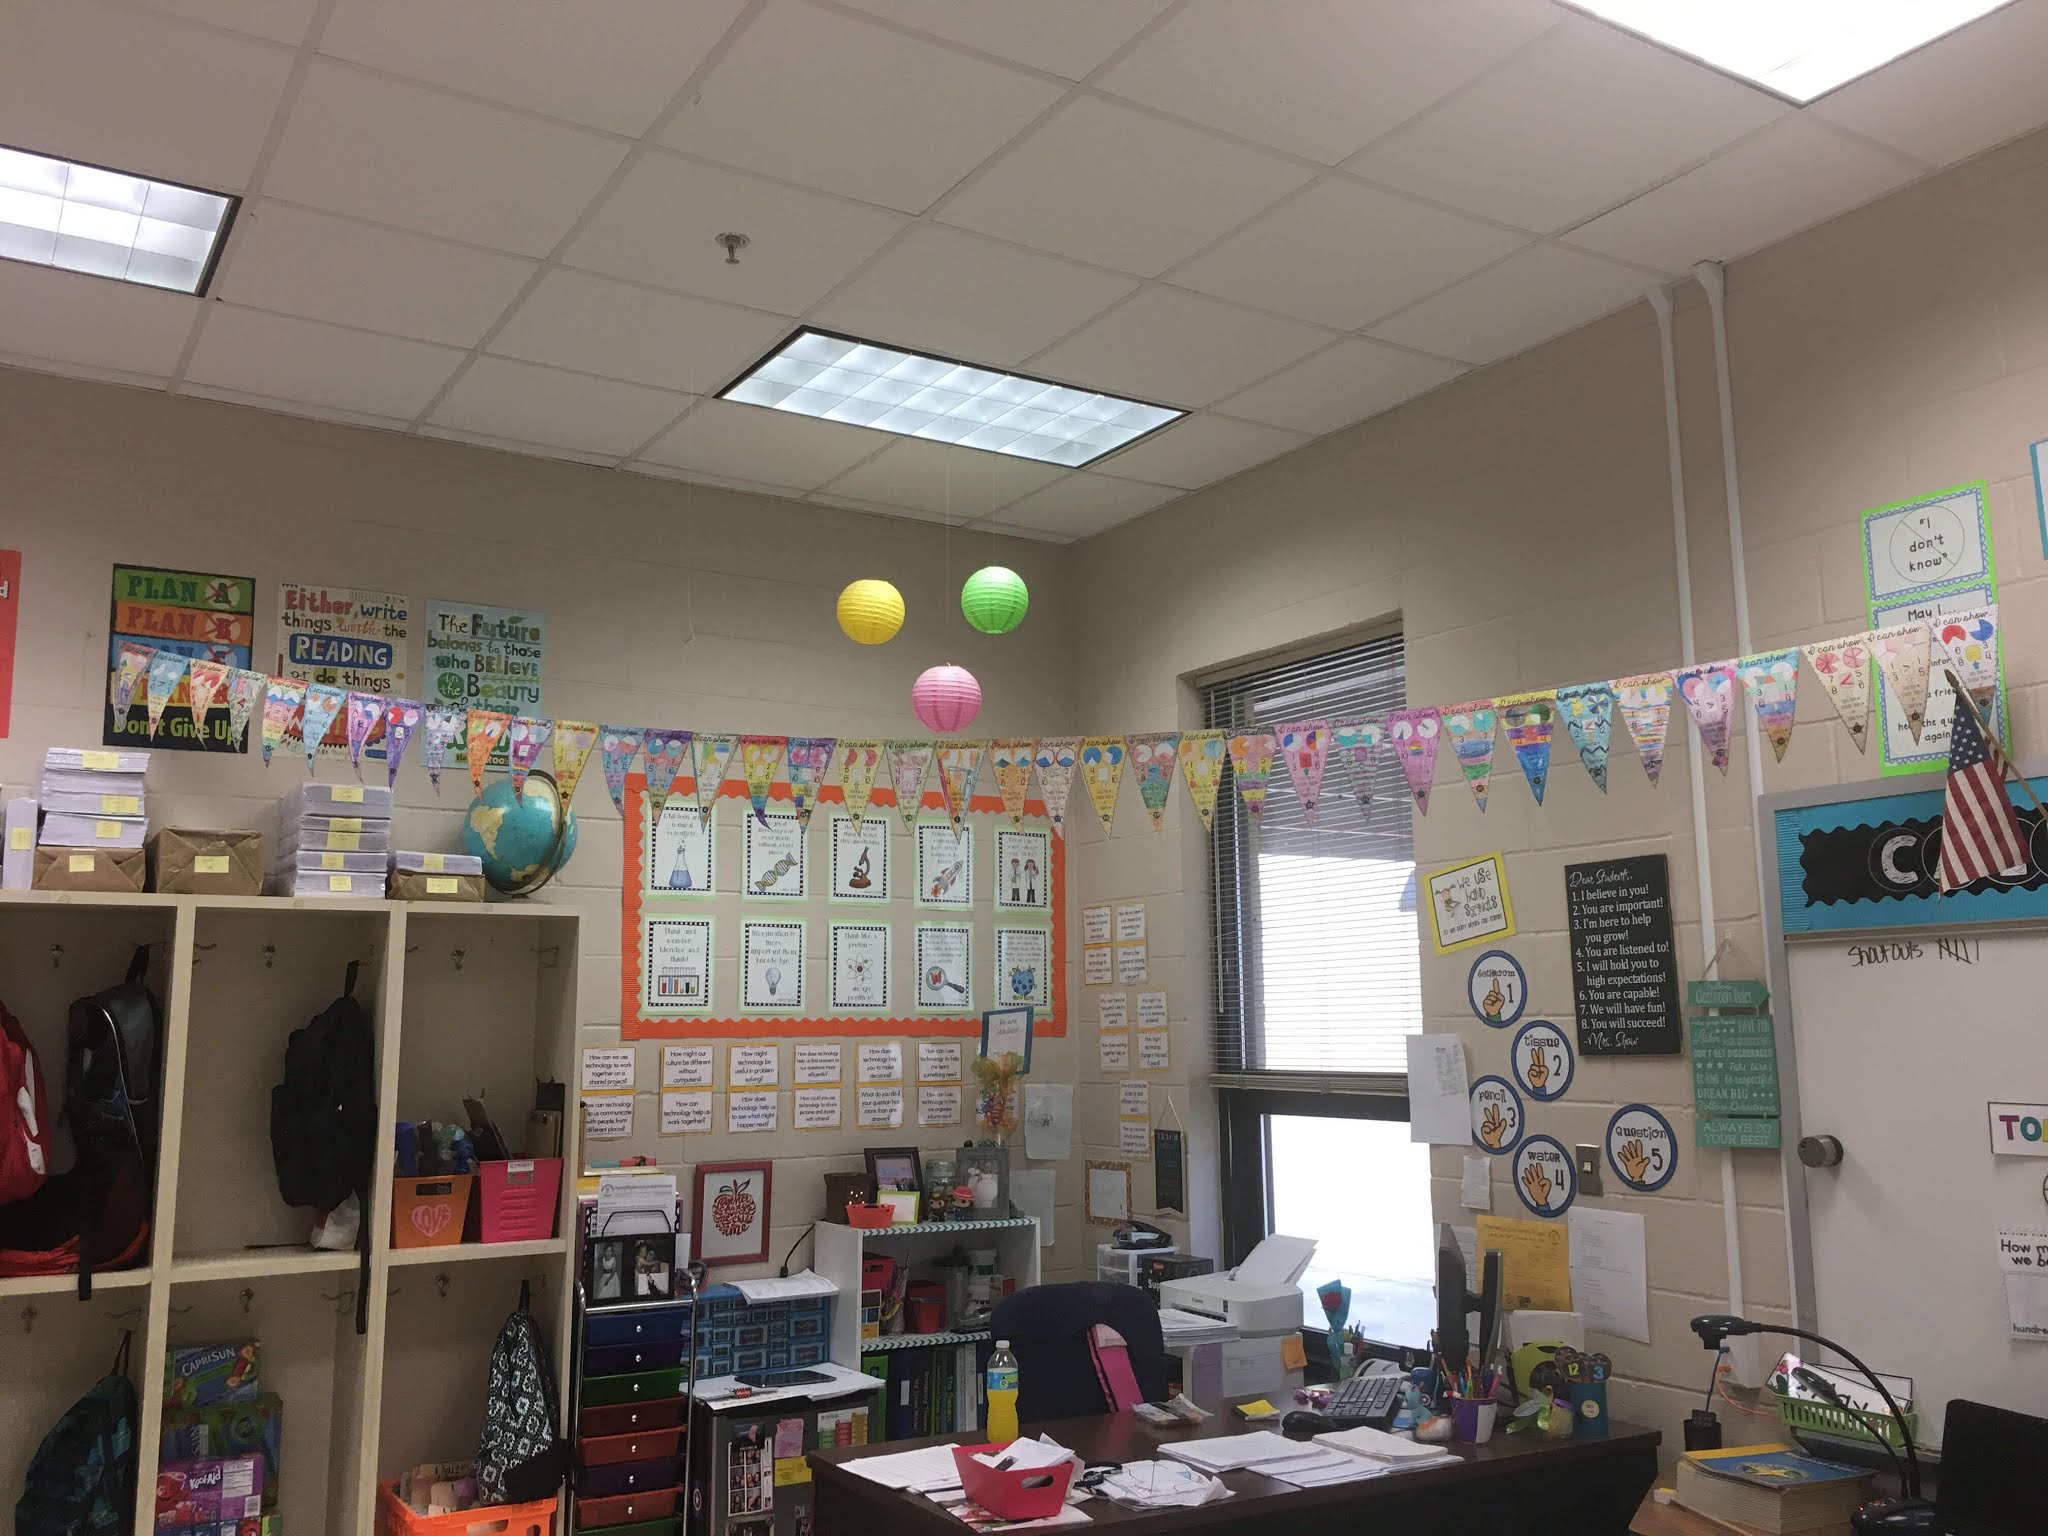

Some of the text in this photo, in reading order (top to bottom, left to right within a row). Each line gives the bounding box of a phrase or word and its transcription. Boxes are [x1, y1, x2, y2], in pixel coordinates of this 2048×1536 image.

[1909, 534, 1944, 553] don't
[127, 575, 232, 604] PLAN A
[360, 604, 408, 620] write
[1908, 608, 1932, 622] May
[126, 606, 232, 640] PLAN B
[282, 610, 406, 638] things worth the
[438, 614, 540, 641] The Future
[1942, 617, 1960, 626] can
[427, 630, 541, 658] belongs to those
[1876, 632, 1895, 640] can
[1817, 644, 1836, 654] can
[1954, 641, 1988, 654] 6 3
[434, 654, 470, 670] who
[1957, 658, 1964, 666] 8
[1985, 652, 1992, 660] 4
[290, 668, 390, 692] or do things
[1854, 670, 1862, 678] 5
[441, 682, 460, 696] the
[1831, 686, 1838, 694] 8
[1568, 872, 1594, 888] Dear
[1572, 884, 1649, 902] 1. I believe in you!
[1572, 897, 1664, 916] 2. You are important!
[1574, 912, 1652, 930] 3. I'm here to help
[1585, 930, 1628, 946] you grow!
[1576, 941, 1670, 958] 4. You are listened to!
[1576, 958, 1659, 972] 5. I will hold you to
[1586, 972, 1666, 988] high expectations!
[1506, 983, 1514, 1003] 1
[1580, 986, 1660, 1002] 6. You are capable!
[1580, 1002, 1666, 1015] 7. We will have fun!
[1582, 1016, 1666, 1030] 8. You will succeed!
[1524, 1034, 1560, 1048] tissue
[1616, 1031, 1639, 1049] Shaw
[683, 1050, 698, 1058] might
[1552, 1054, 1562, 1076] 2
[1478, 1088, 1506, 1103] pencil
[1697, 1088, 1748, 1100] DREAM BIG
[1506, 1106, 1516, 1128] 3
[1704, 1122, 1772, 1134] ALWAYS DO
[1998, 1114, 2048, 1142] TO
[1704, 1134, 1770, 1146] YOUR BEST
[1651, 1148, 1663, 1171] 5
[1555, 1169, 1564, 1191] 4
[2000, 1239, 2031, 1253] How
[2012, 1256, 2032, 1266] we
[1568, 1363, 1580, 1376] 12
[1593, 1365, 1604, 1380] 3
[189, 1468, 221, 1490] Kool-Aid
